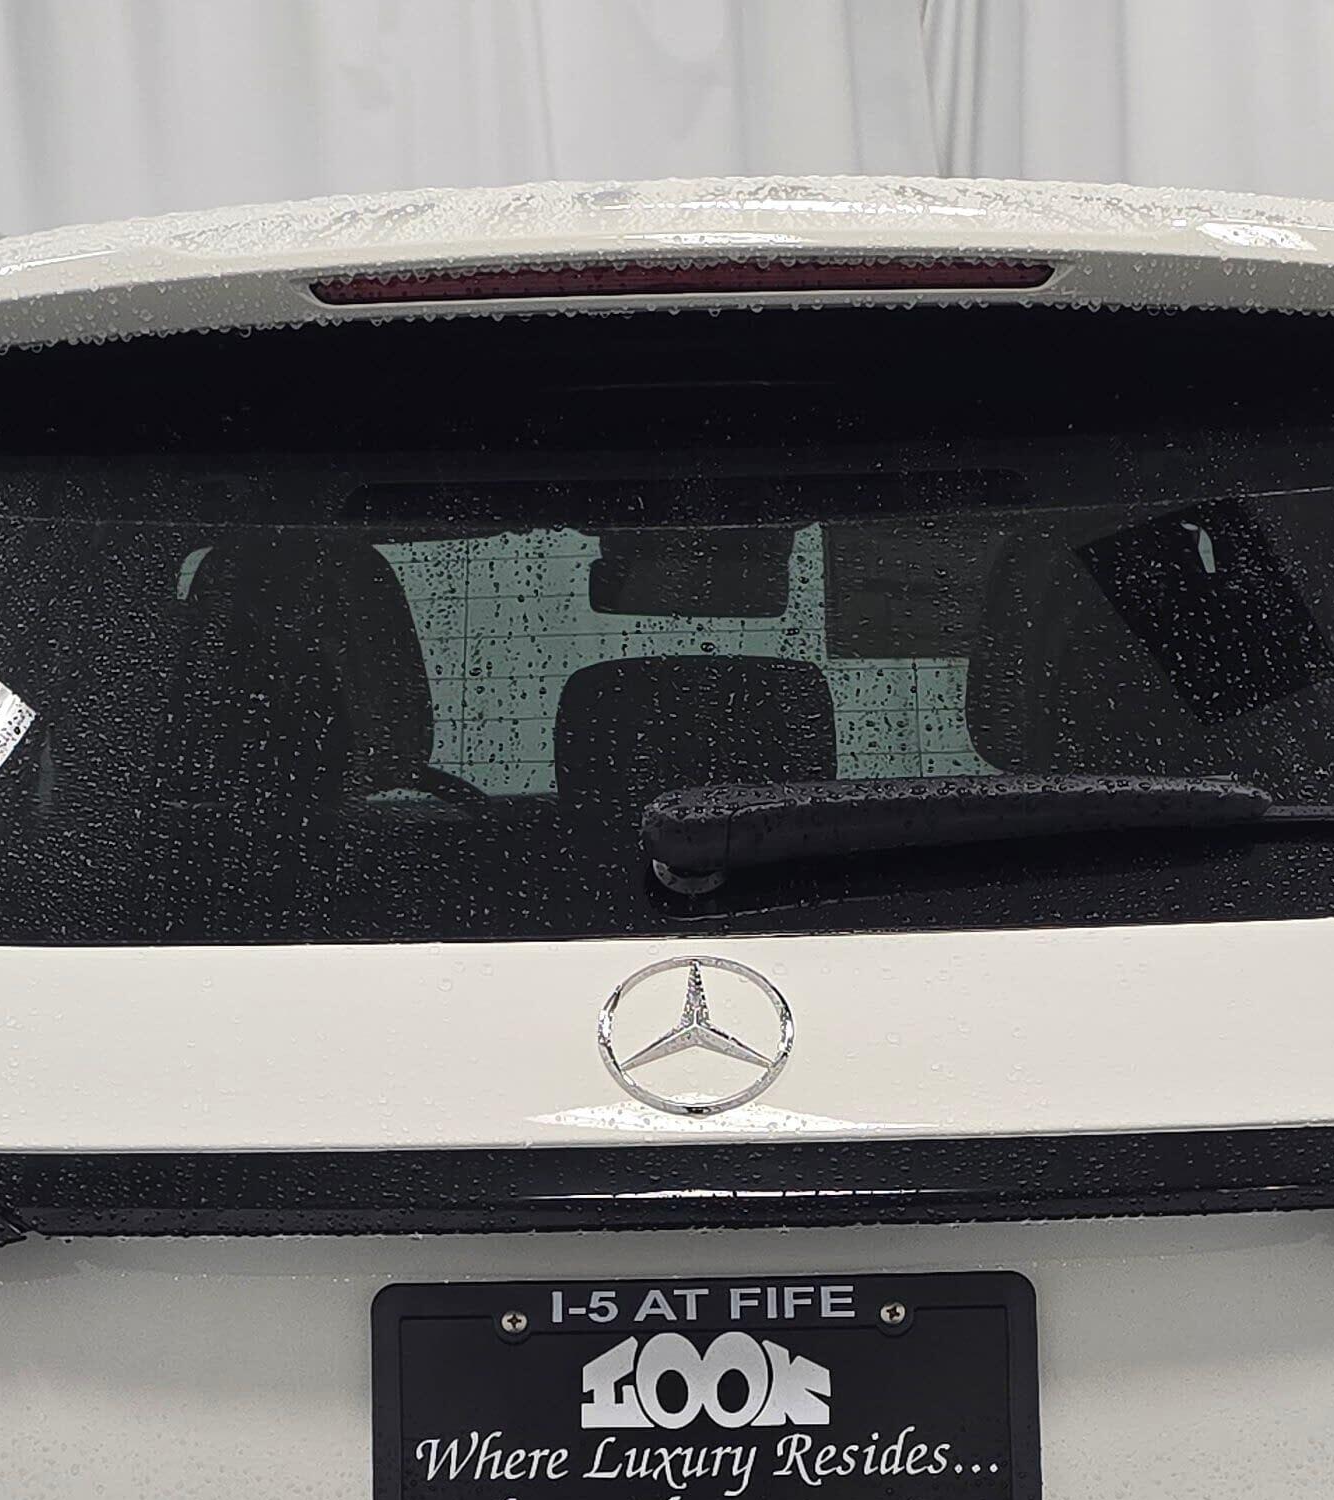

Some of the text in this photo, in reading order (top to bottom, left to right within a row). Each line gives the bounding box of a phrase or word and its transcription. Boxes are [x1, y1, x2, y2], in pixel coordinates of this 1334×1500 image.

[552, 1286, 856, 1323] I-5 AT FIFE
[581, 1331, 832, 1430] LOOK
[415, 1425, 999, 1497] Where Luxury Resides...
